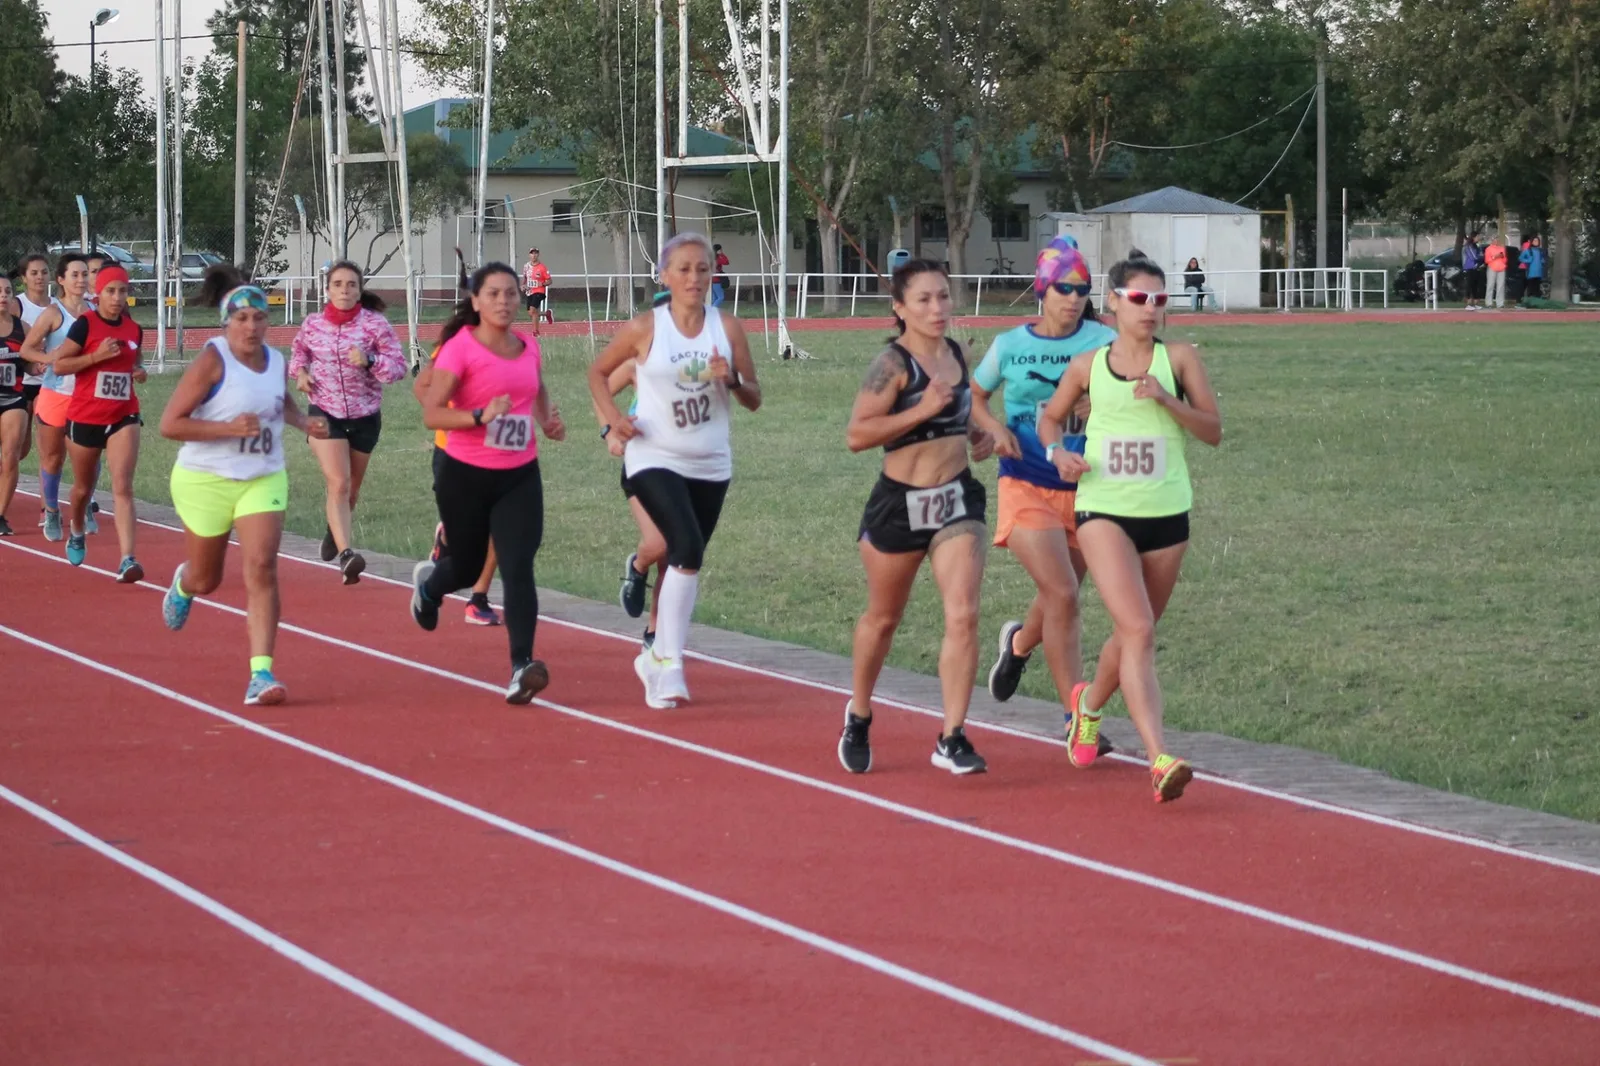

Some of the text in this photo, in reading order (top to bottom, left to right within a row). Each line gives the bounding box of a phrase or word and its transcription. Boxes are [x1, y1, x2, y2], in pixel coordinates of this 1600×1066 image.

[670, 351, 708, 363] CACTU
[1011, 355, 1072, 365] LOS PUM
[102, 375, 127, 397] 552
[672, 394, 710, 428] 502
[495, 418, 526, 446] 729
[1108, 441, 1154, 475] 555
[917, 488, 956, 525] 725
